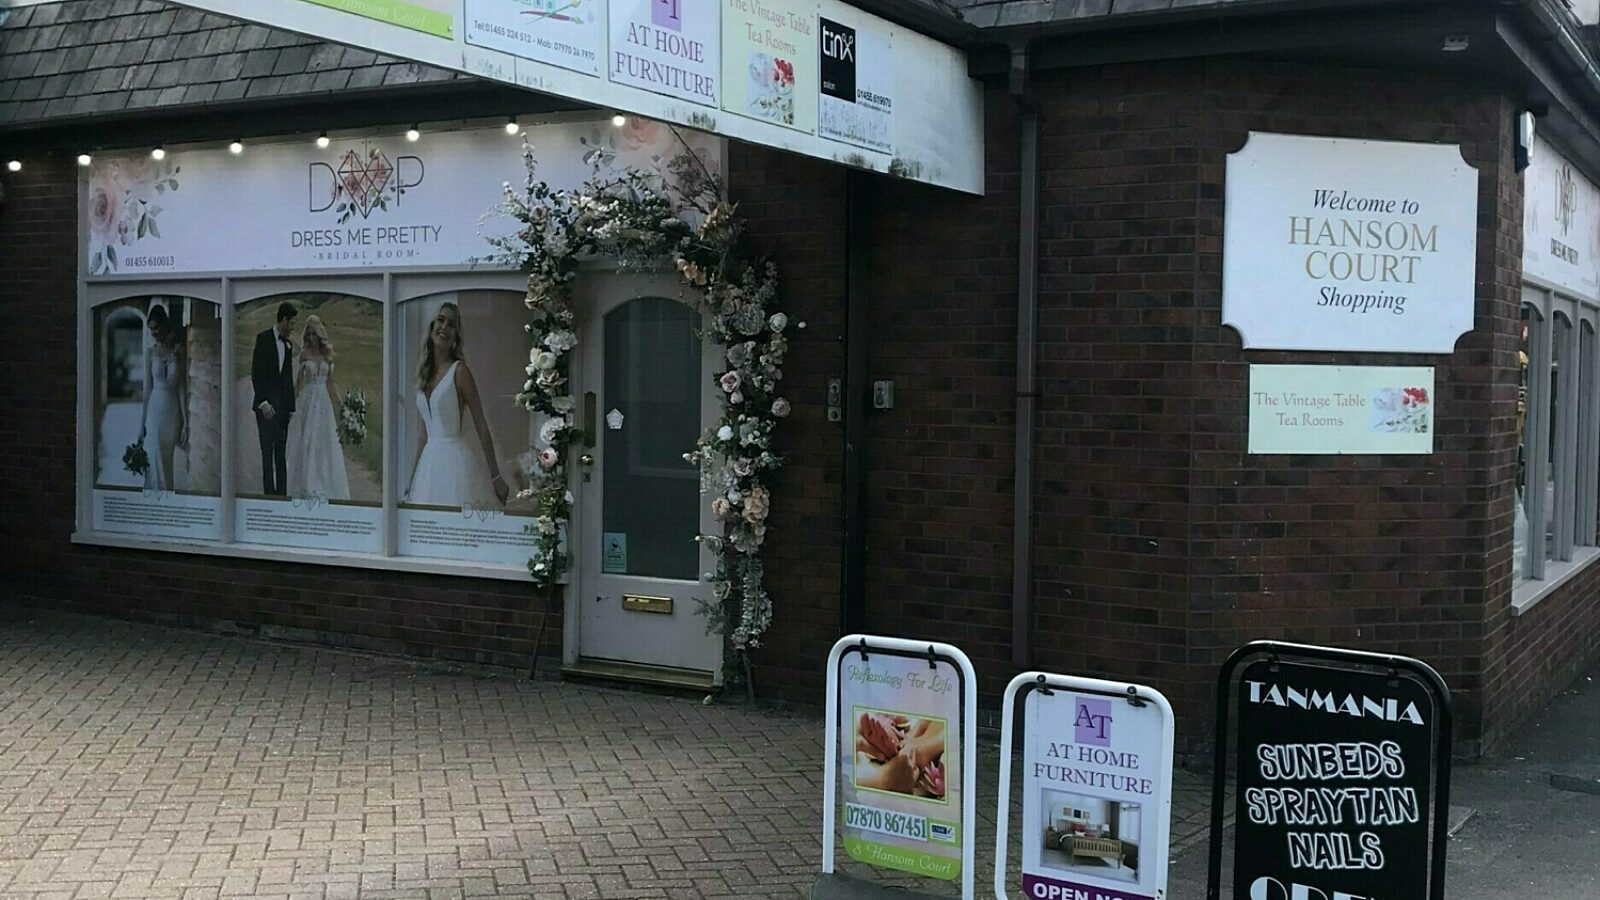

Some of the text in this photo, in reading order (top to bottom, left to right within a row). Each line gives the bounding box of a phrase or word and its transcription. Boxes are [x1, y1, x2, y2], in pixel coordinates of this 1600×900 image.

[749, 0, 787, 28] Vintage
[787, 11, 811, 36] Table
[626, 21, 704, 64] AT HOME
[745, 22, 797, 55] Tea Rooms
[614, 51, 715, 98] FURNITURE
[1312, 188, 1420, 216] Welcome to
[291, 224, 442, 248] DRESS ME PRETTY
[1287, 215, 1440, 253] HANSOM
[125, 255, 175, 268] 01455 610013
[1305, 250, 1422, 284] COURT
[1316, 286, 1408, 316] Shopping
[1253, 392, 1367, 409] The Vintage Table
[1275, 412, 1345, 427] Tea Rooms
[847, 664, 903, 690] Reflexology
[906, 672, 926, 689] For
[1245, 680, 1425, 726] TANMANIA
[1046, 742, 1140, 770] AT HOME
[1257, 740, 1406, 780] SUNBEDS
[1033, 762, 1153, 795] FURNITURE
[846, 804, 928, 839] 07870 867451
[1245, 787, 1420, 825] SPRAYTAN
[865, 843, 915, 867] Hansom
[918, 854, 952, 874] Court
[1287, 831, 1385, 870] NAILS
